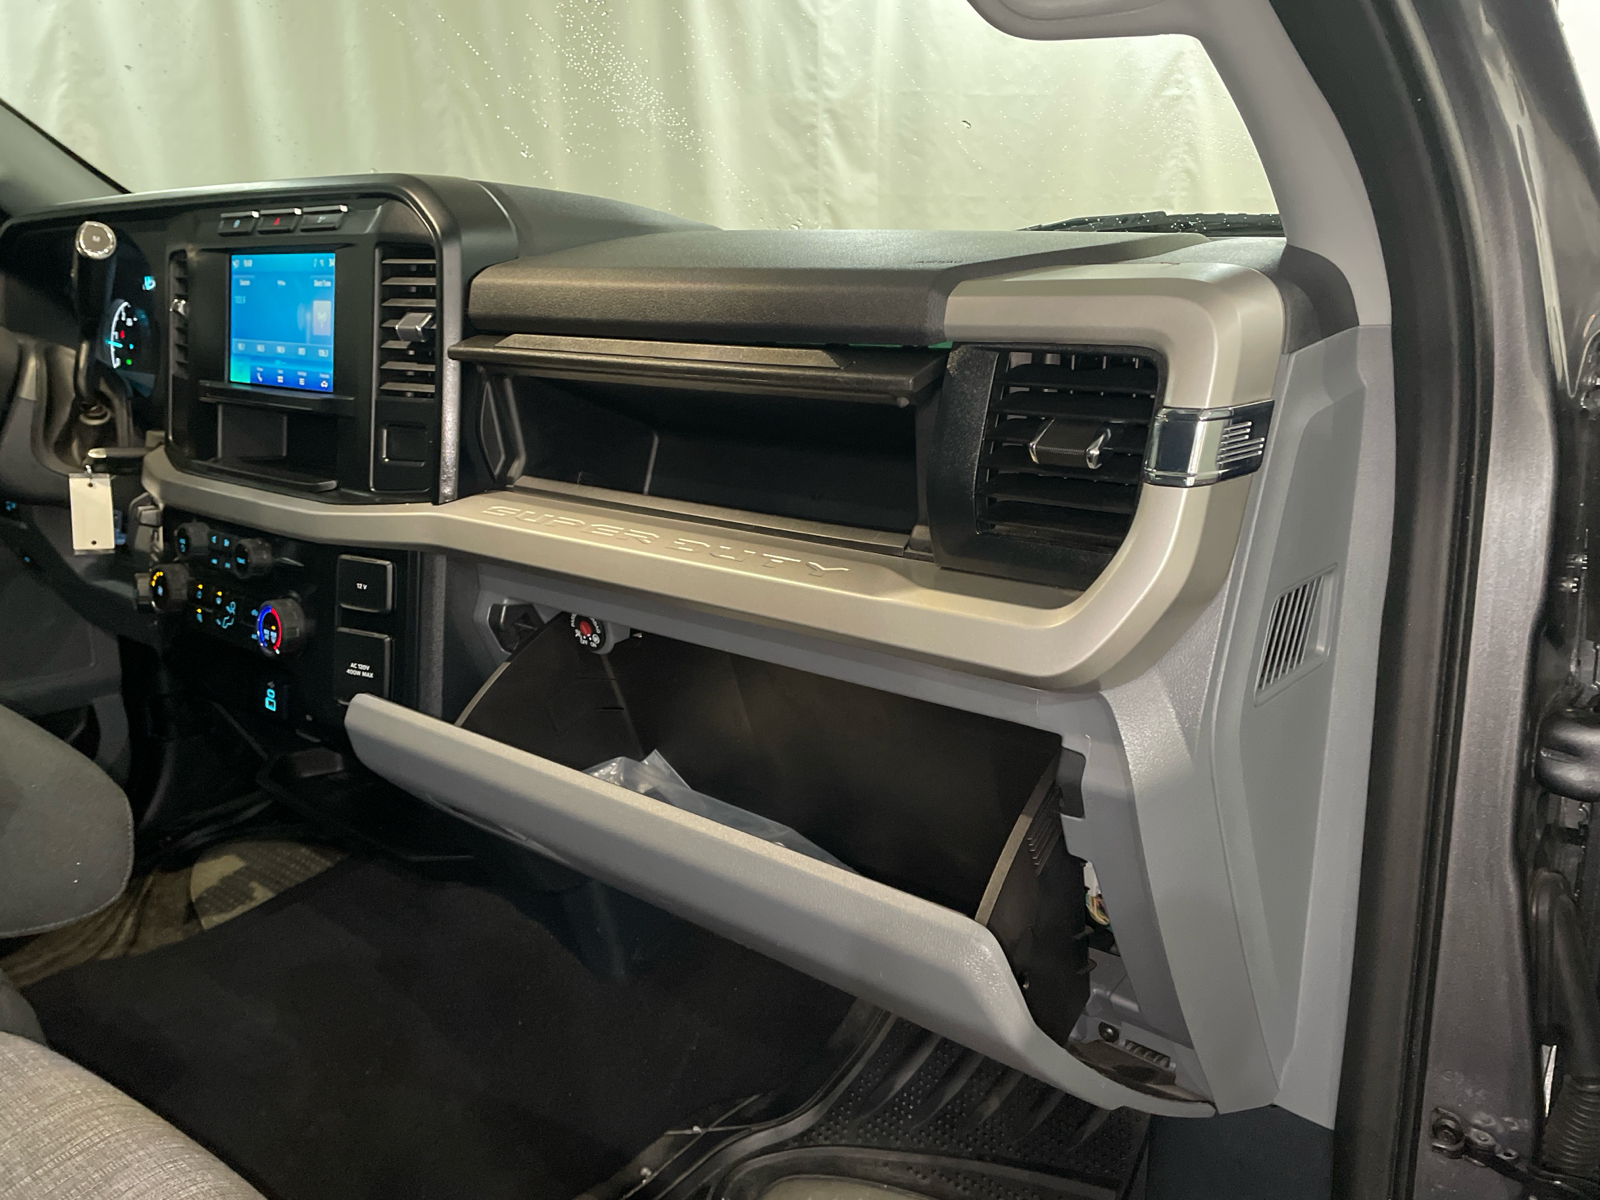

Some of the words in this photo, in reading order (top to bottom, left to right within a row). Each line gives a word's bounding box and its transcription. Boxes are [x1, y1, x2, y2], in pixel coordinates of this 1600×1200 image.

[481, 505, 660, 545] SUPER
[665, 538, 849, 577] DUTY
[357, 663, 370, 671] 120V
[346, 668, 361, 676] 400W
